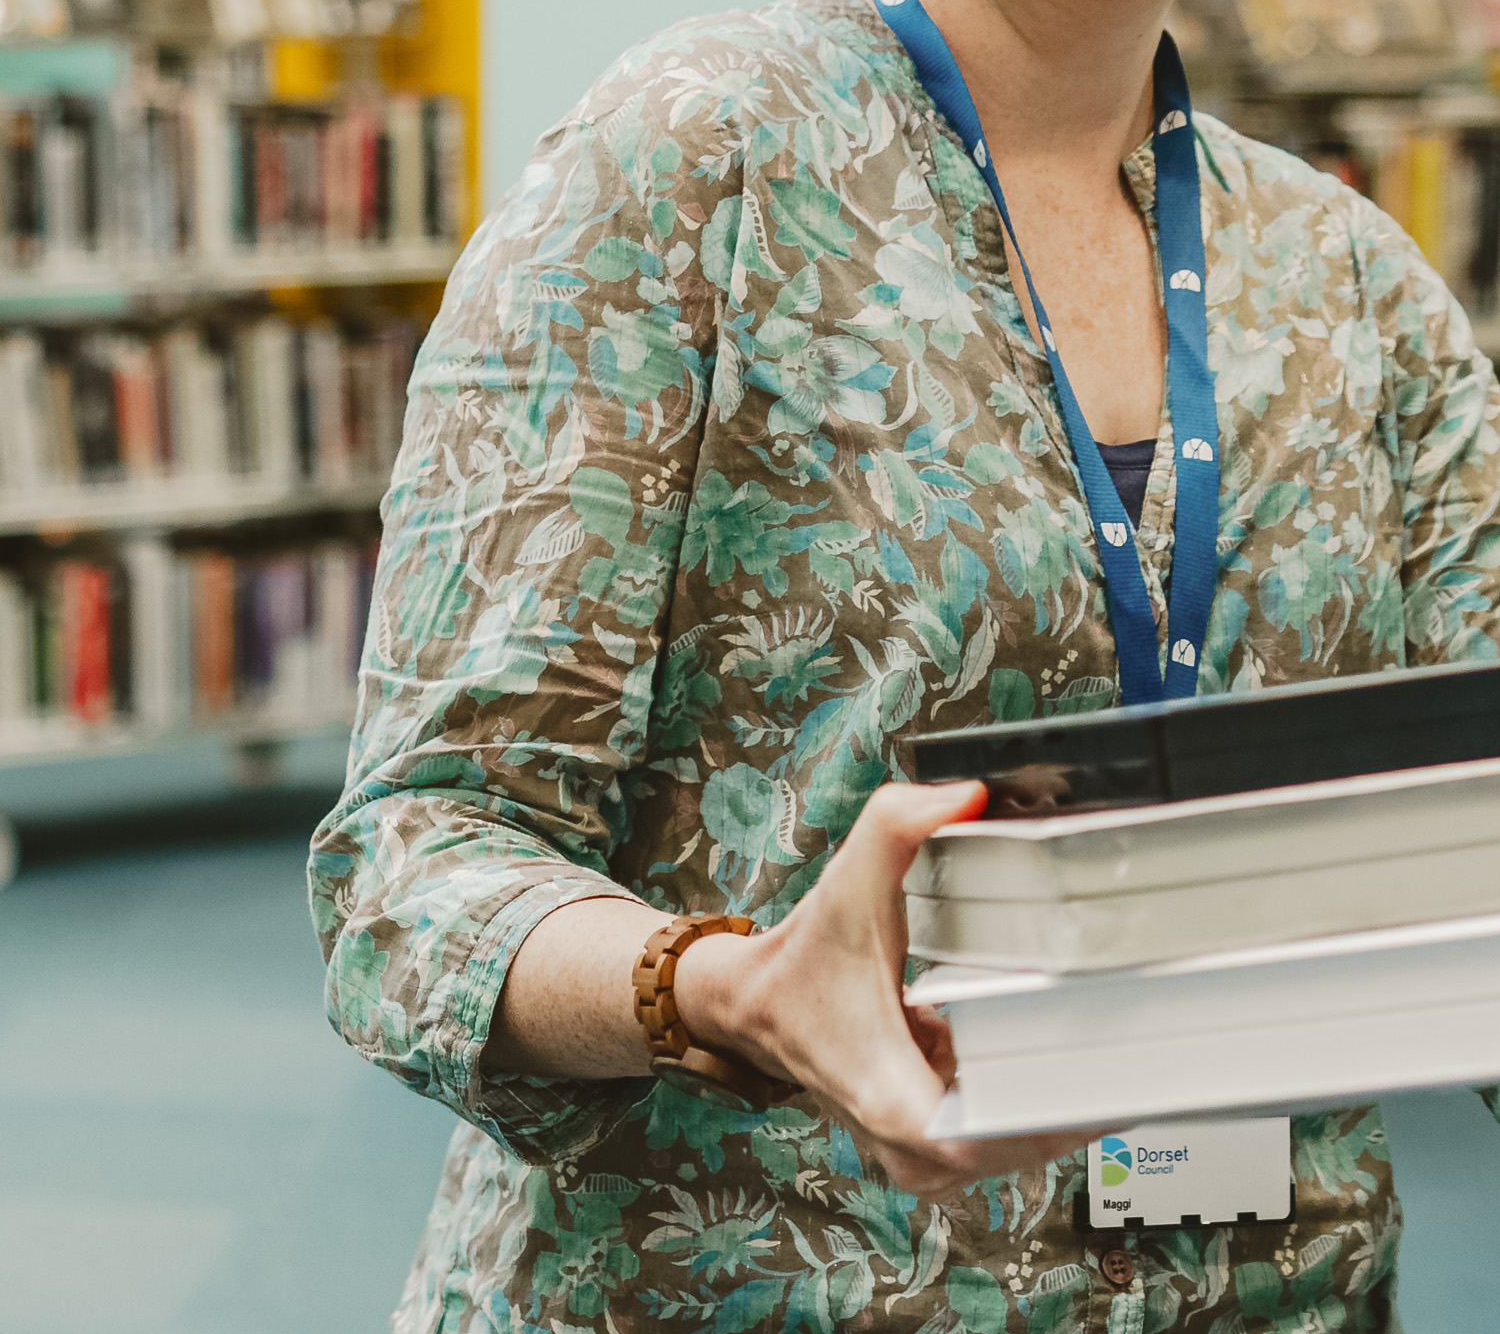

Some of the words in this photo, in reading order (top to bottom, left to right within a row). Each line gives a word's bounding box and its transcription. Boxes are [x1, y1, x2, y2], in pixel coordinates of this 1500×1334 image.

[1137, 1145, 1189, 1163] Dorset
[1137, 1164, 1174, 1175] Council
[1102, 1198, 1132, 1211] Maggi
